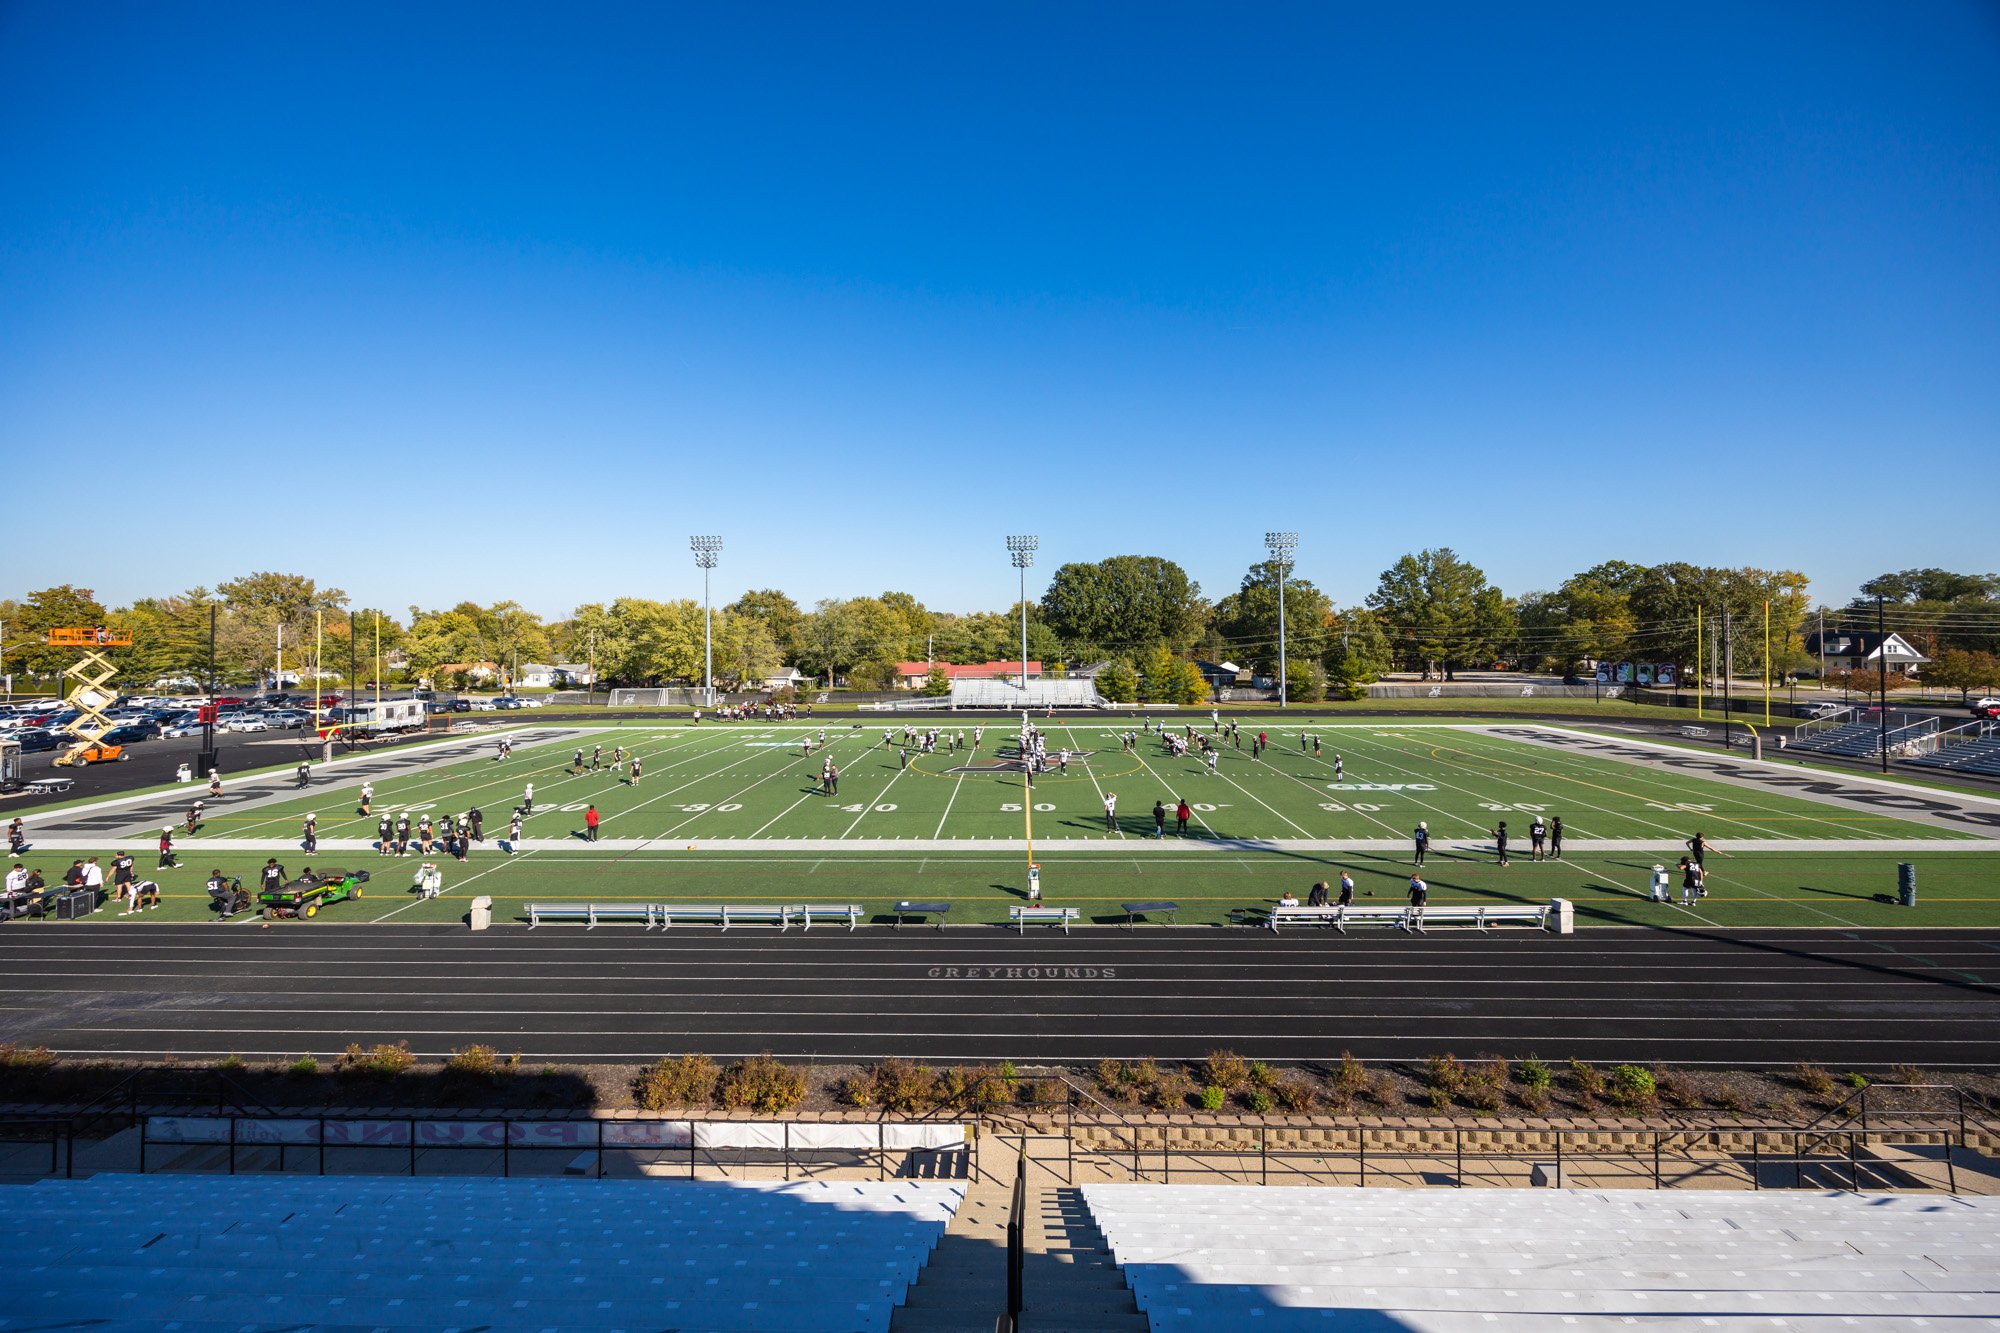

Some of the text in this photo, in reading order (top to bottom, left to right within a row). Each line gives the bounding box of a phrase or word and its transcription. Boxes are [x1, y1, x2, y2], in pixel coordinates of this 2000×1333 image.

[682, 803, 743, 812] 30
[841, 803, 898, 812] 40
[1000, 803, 1057, 812] 50
[1162, 803, 1217, 812] 40
[1318, 803, 1380, 812] 30
[1478, 802, 1546, 812] 20
[1645, 802, 1713, 812] 10
[1534, 827, 1544, 835] 27
[119, 858, 133, 868] 90
[1689, 862, 1699, 871] 24
[267, 868, 279, 878] 16
[207, 881, 219, 891] 51
[927, 967, 1116, 978] GREYHOUNDS
